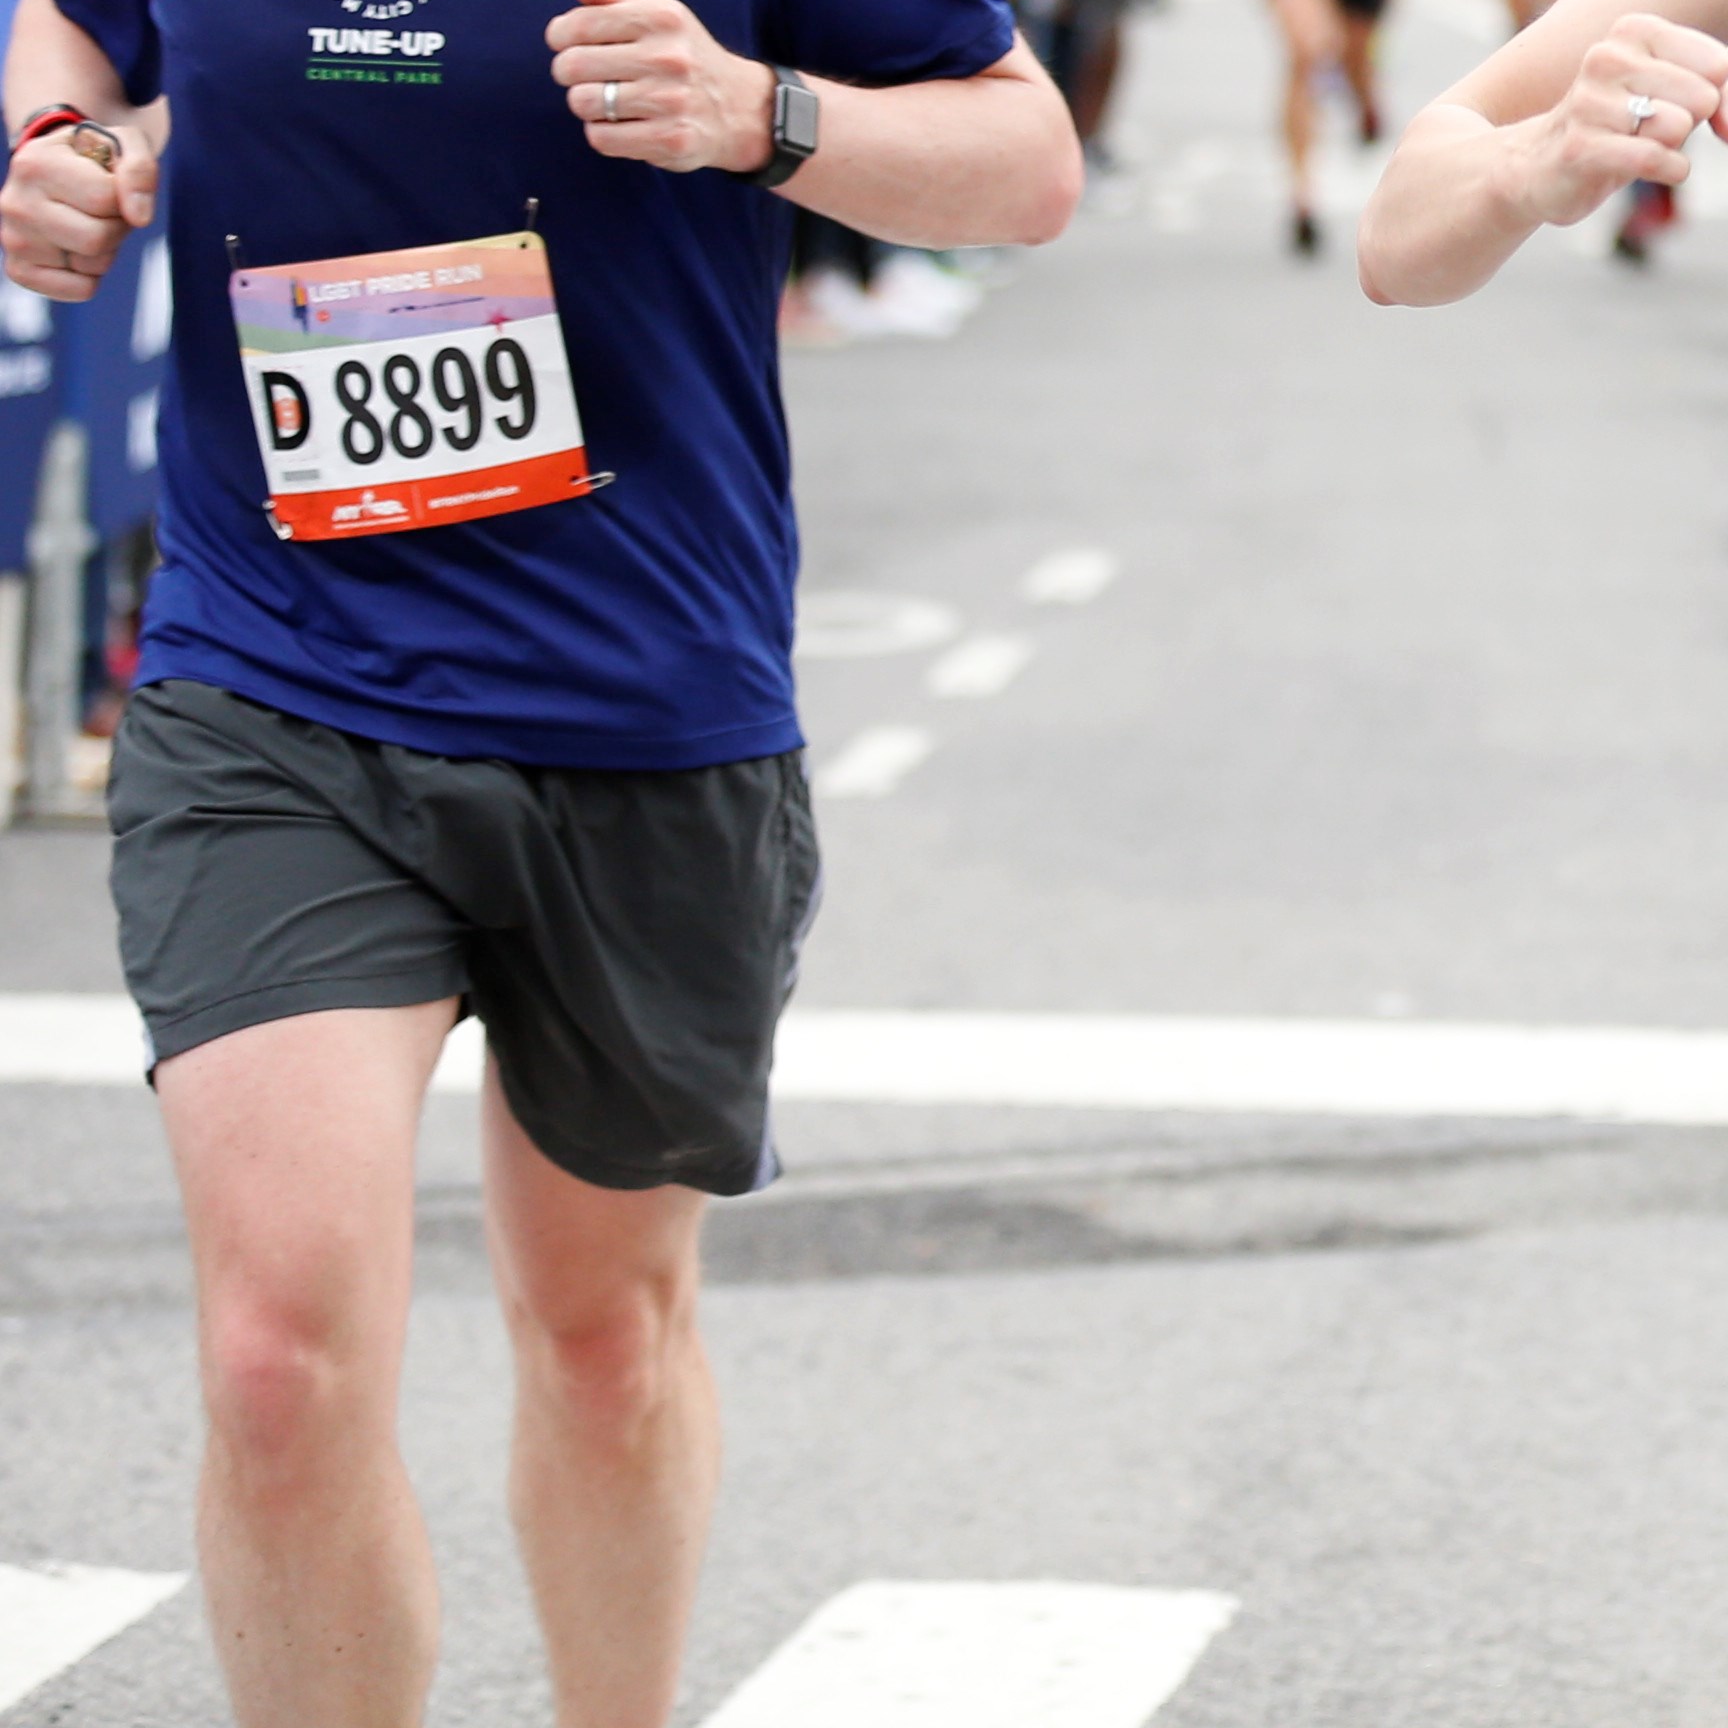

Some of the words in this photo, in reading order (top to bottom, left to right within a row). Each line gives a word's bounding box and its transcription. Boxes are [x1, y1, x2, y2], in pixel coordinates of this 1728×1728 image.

[361, 0, 414, 20] CITY
[307, 27, 446, 56] TUNE-UP
[306, 68, 390, 82] CENTRAL
[394, 71, 442, 84] PARK
[308, 280, 363, 303] LGBT
[365, 271, 433, 296] PRIDE
[433, 264, 483, 287] RUN
[262, 371, 310, 451] D
[335, 338, 536, 465] 8899
